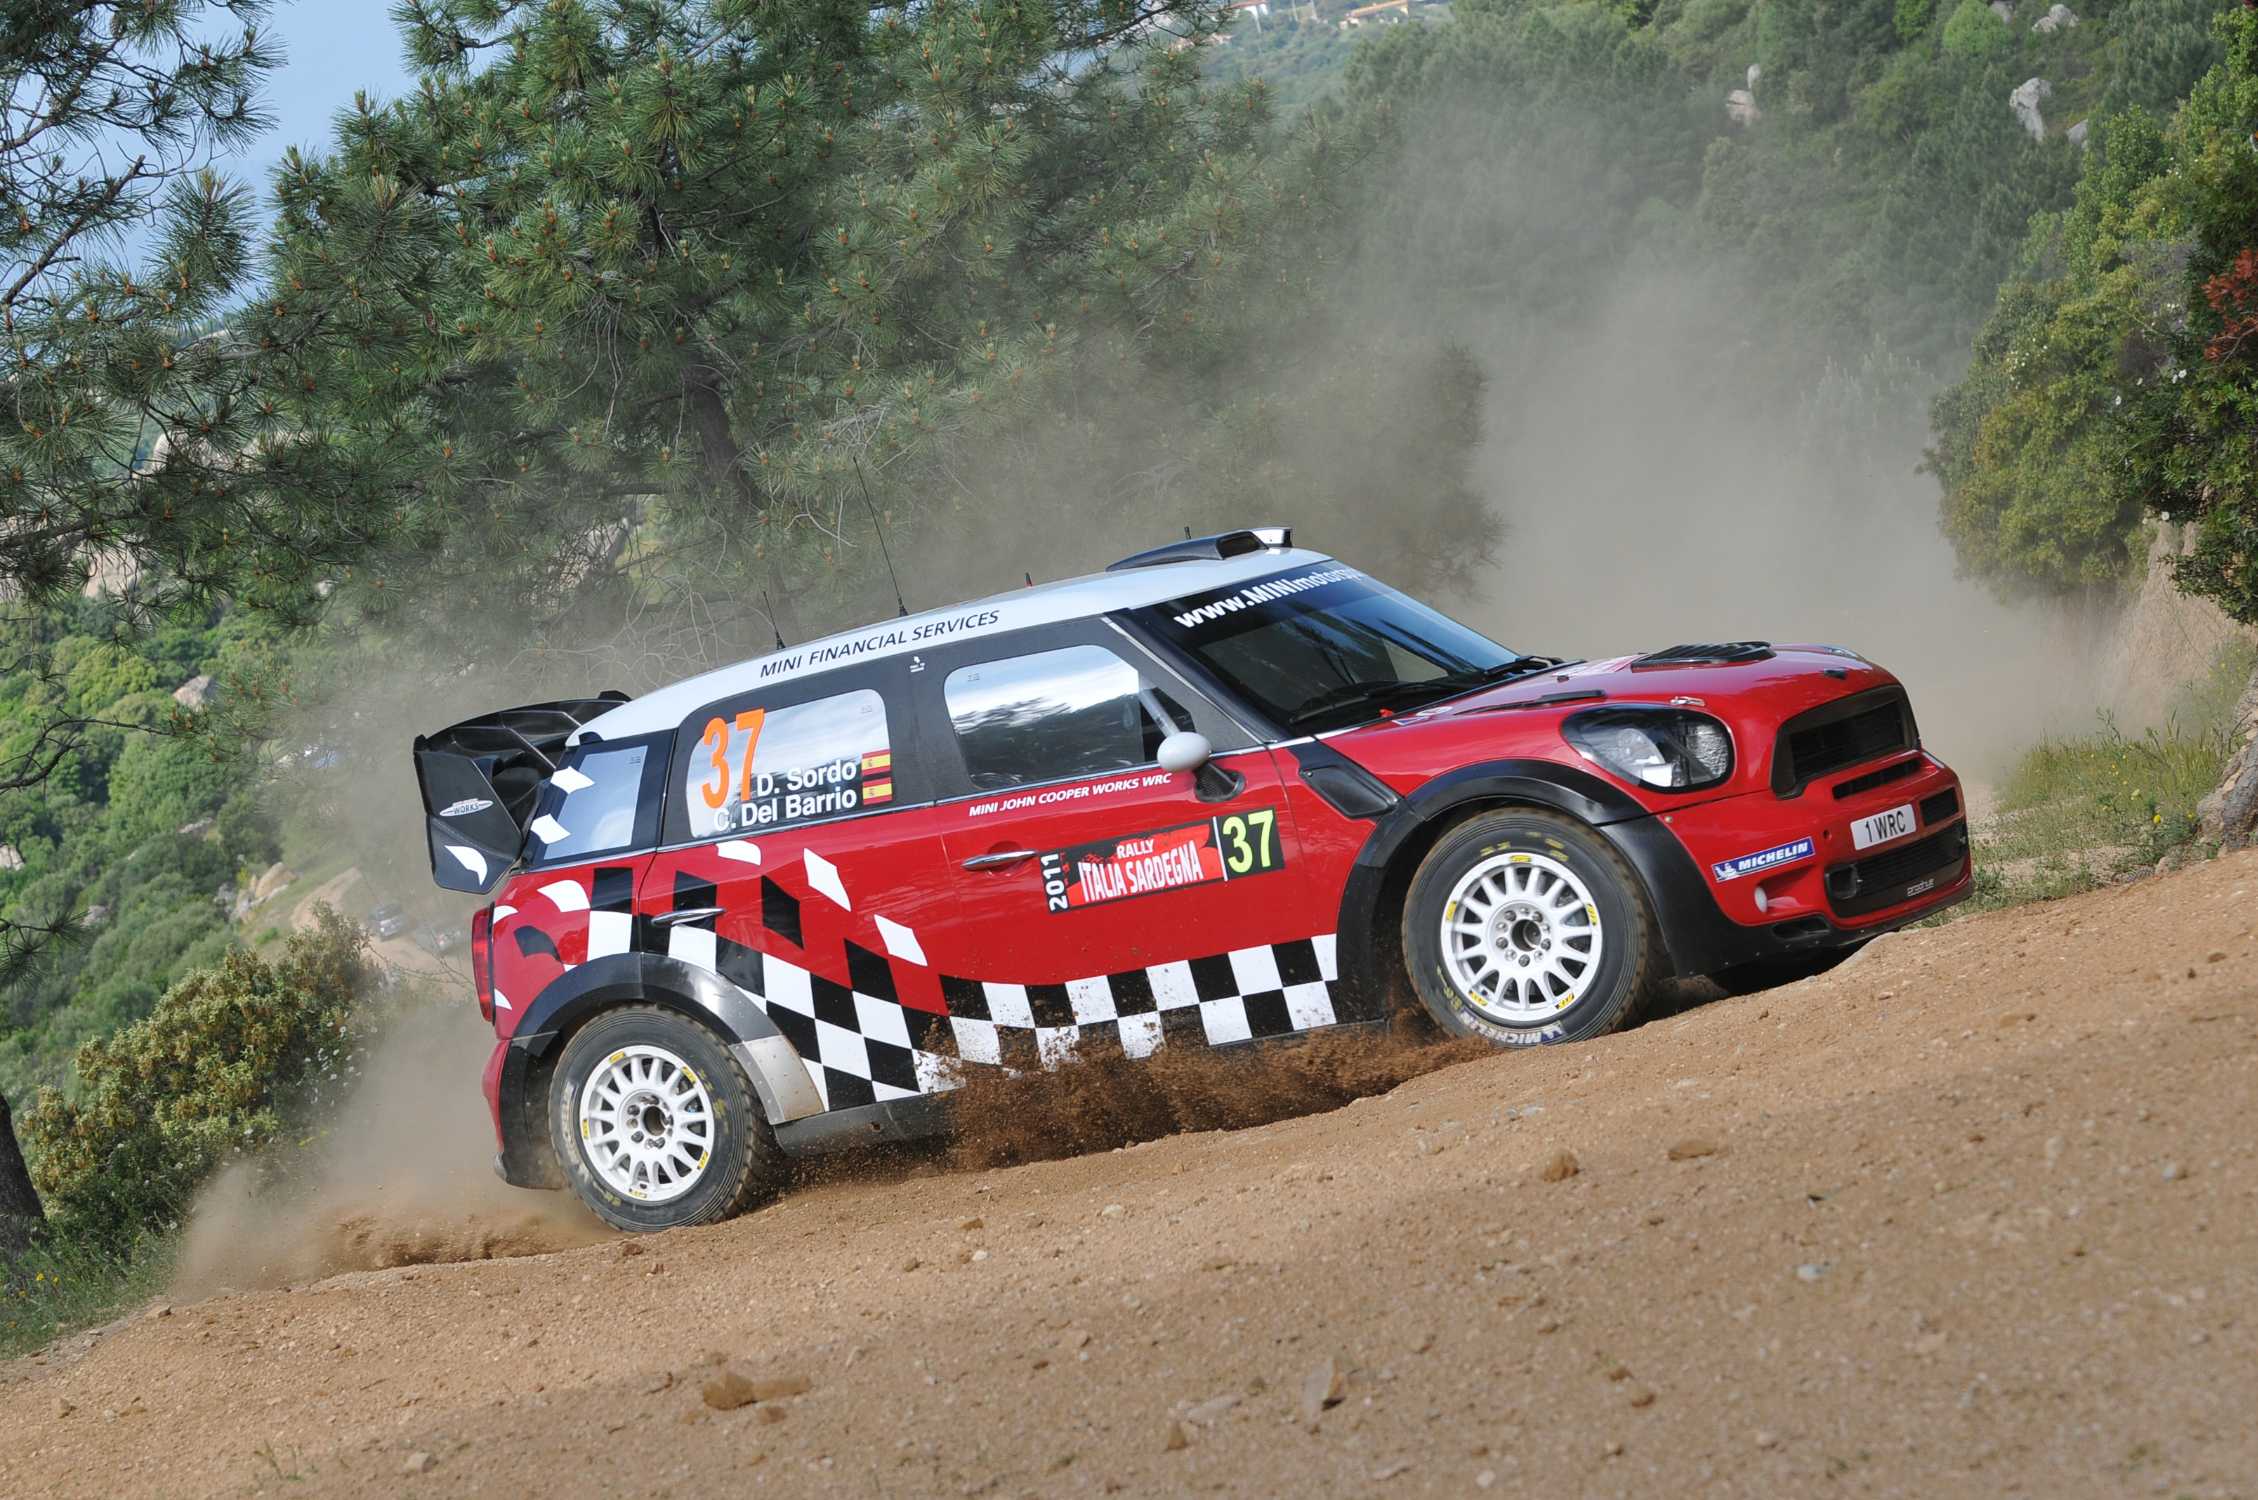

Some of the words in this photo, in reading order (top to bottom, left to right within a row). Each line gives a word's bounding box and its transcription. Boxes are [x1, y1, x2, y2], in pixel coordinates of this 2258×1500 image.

[760, 655, 803, 678] MINI
[809, 631, 907, 665] FINANCIAL
[912, 610, 1000, 641] SERVICES
[702, 708, 765, 808] 37
[757, 773, 780, 796] D.
[787, 760, 857, 791] Sordo
[714, 808, 736, 831] C.
[741, 799, 778, 827] Del
[785, 787, 857, 819] Barrio
[969, 803, 998, 816] MINI
[1000, 795, 1036, 811] JOHN
[1038, 787, 1089, 804] COOPER
[1092, 778, 1140, 795] WORKS
[1142, 773, 1172, 787] WRC
[1116, 839, 1154, 859] RALLY
[1222, 809, 1274, 873] 37
[1865, 819, 1873, 843] 1
[1875, 811, 1906, 840] WRC
[1078, 862, 1127, 902] ITALIA
[1125, 840, 1204, 893] SARDEGNA
[1738, 841, 1809, 870] MICHELIN
[1041, 853, 1068, 911] 2011
